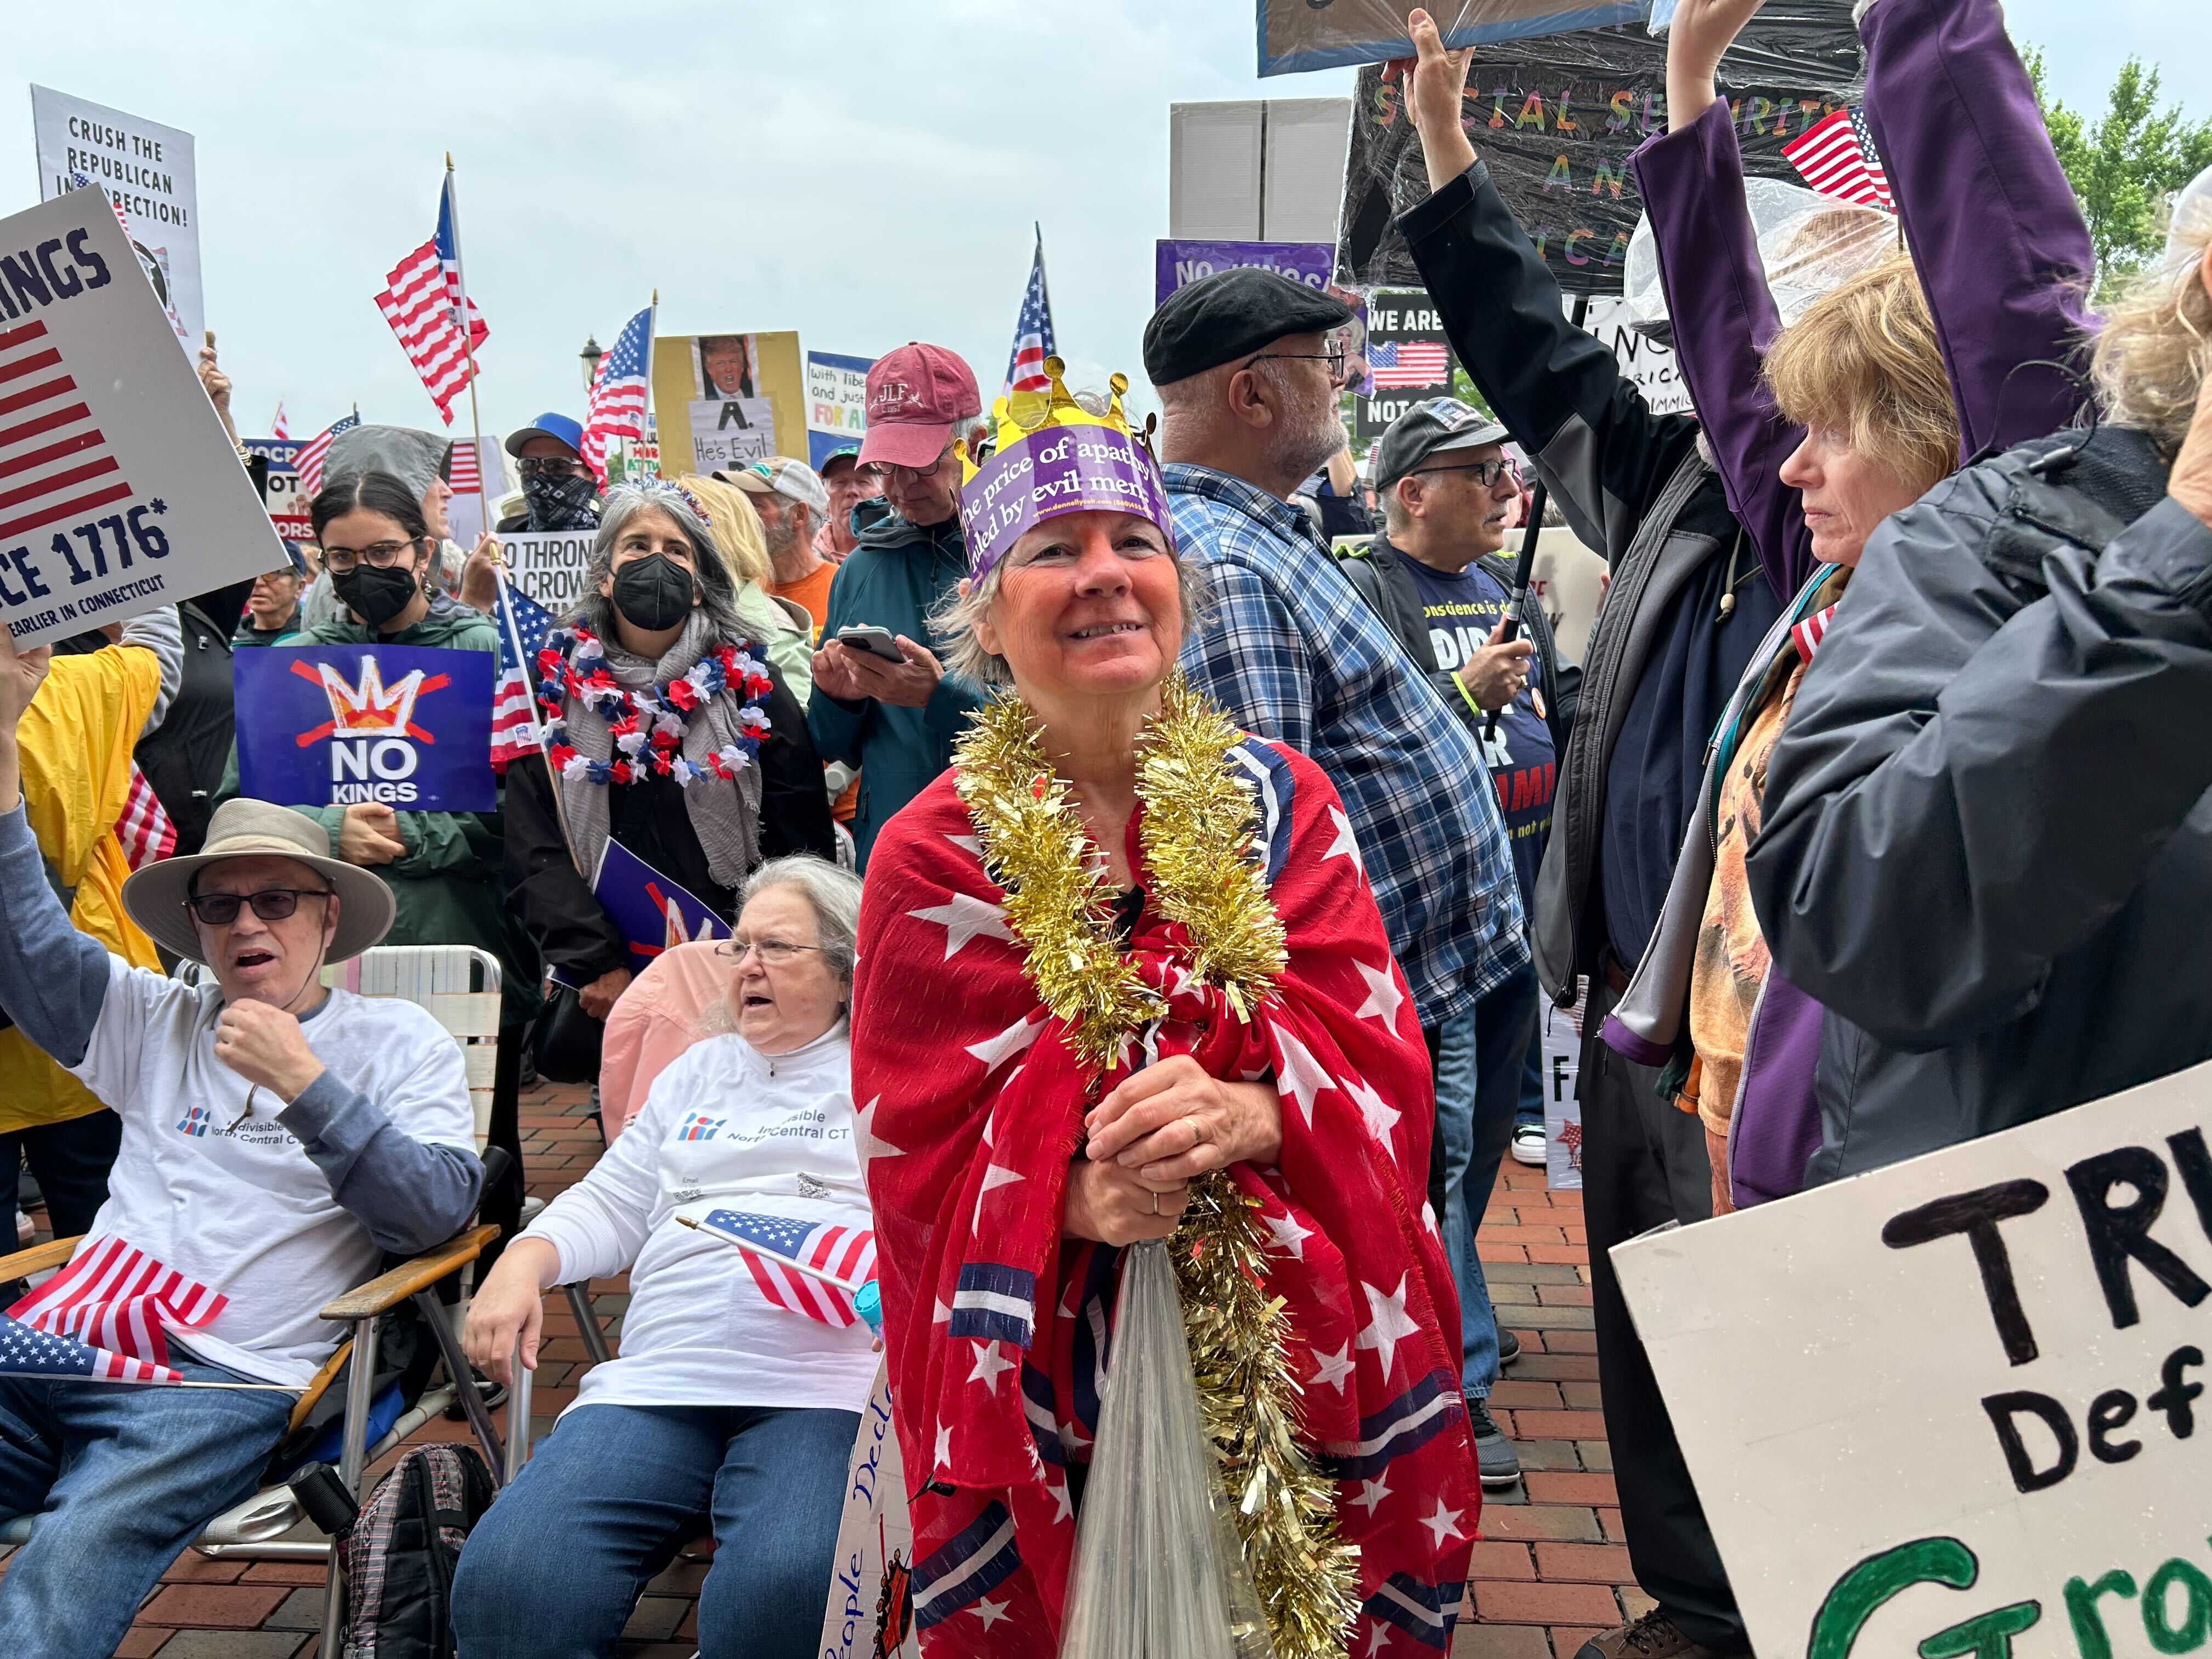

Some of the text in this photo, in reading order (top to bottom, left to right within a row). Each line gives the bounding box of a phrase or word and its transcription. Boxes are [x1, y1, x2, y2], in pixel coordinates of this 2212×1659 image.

[1372, 84, 1576, 132] SIAL
[69, 116, 163, 163] CRUSH THE
[67, 146, 173, 195] REPUBLICAN
[57, 175, 188, 228] INRECTION!
[1368, 311, 1444, 331] WE ARE
[810, 368, 865, 387] with libe
[811, 386, 836, 400] and
[879, 383, 909, 402] JLF
[814, 403, 844, 427] FOR
[694, 433, 768, 461] He's Evil
[983, 456, 1034, 511] price
[1039, 437, 1070, 464] of
[1076, 442, 1149, 481] apathy
[971, 514, 1000, 573] ruled
[999, 495, 1026, 528] by
[1031, 470, 1082, 505] evil
[1088, 475, 1150, 504] men.
[522, 539, 597, 568] THRON
[8, 574, 165, 638] EARLIER IN CONNECTICUT
[1484, 599, 1498, 615] is
[332, 738, 417, 781] NO
[332, 782, 418, 804] KINGS
[240, 1134, 283, 1144] Central
[286, 1135, 301, 1146] C
[769, 1127, 823, 1139] Central
[828, 1128, 850, 1139] CT
[1980, 1345, 2205, 1494] Def
[1806, 1536, 2212, 1659] Gro
